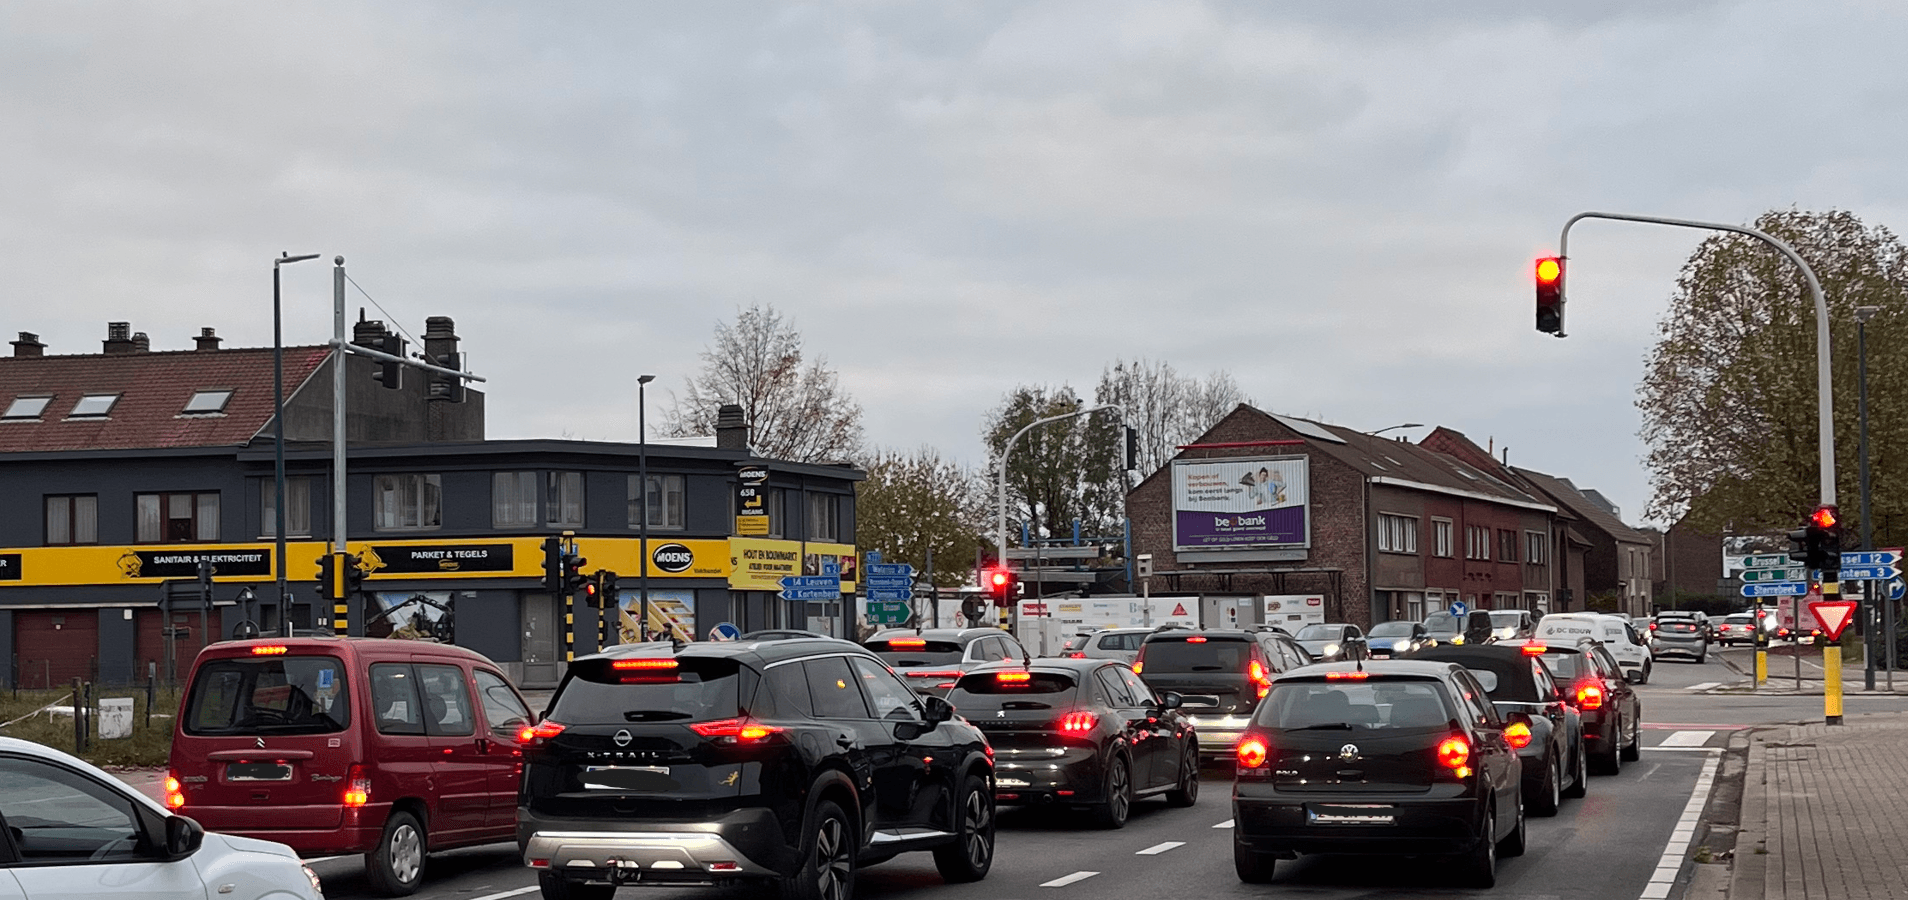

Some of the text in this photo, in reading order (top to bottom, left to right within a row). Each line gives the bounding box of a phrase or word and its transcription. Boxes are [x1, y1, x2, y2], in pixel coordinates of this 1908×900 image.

[739, 470, 766, 478] MOENS
[153, 554, 262, 564] SANITAIR & ELEKTRICITEIT
[411, 550, 488, 559] PARKET & TEGELS
[656, 552, 690, 563] MOENS
[743, 549, 757, 559] HOUT
[766, 550, 797, 561] BOUWMARKT
[1841, 553, 1882, 564] ssel 12
[1752, 556, 1780, 566] Brussel
[1758, 571, 1773, 580] Luik
[1877, 567, 1885, 577] 3
[793, 577, 801, 586] 14
[806, 578, 833, 586] Leuven
[787, 590, 840, 599] 2 Kortenberg
[1754, 584, 1797, 595] Sterrebeek
[587, 751, 660, 759] X-TRAIL
